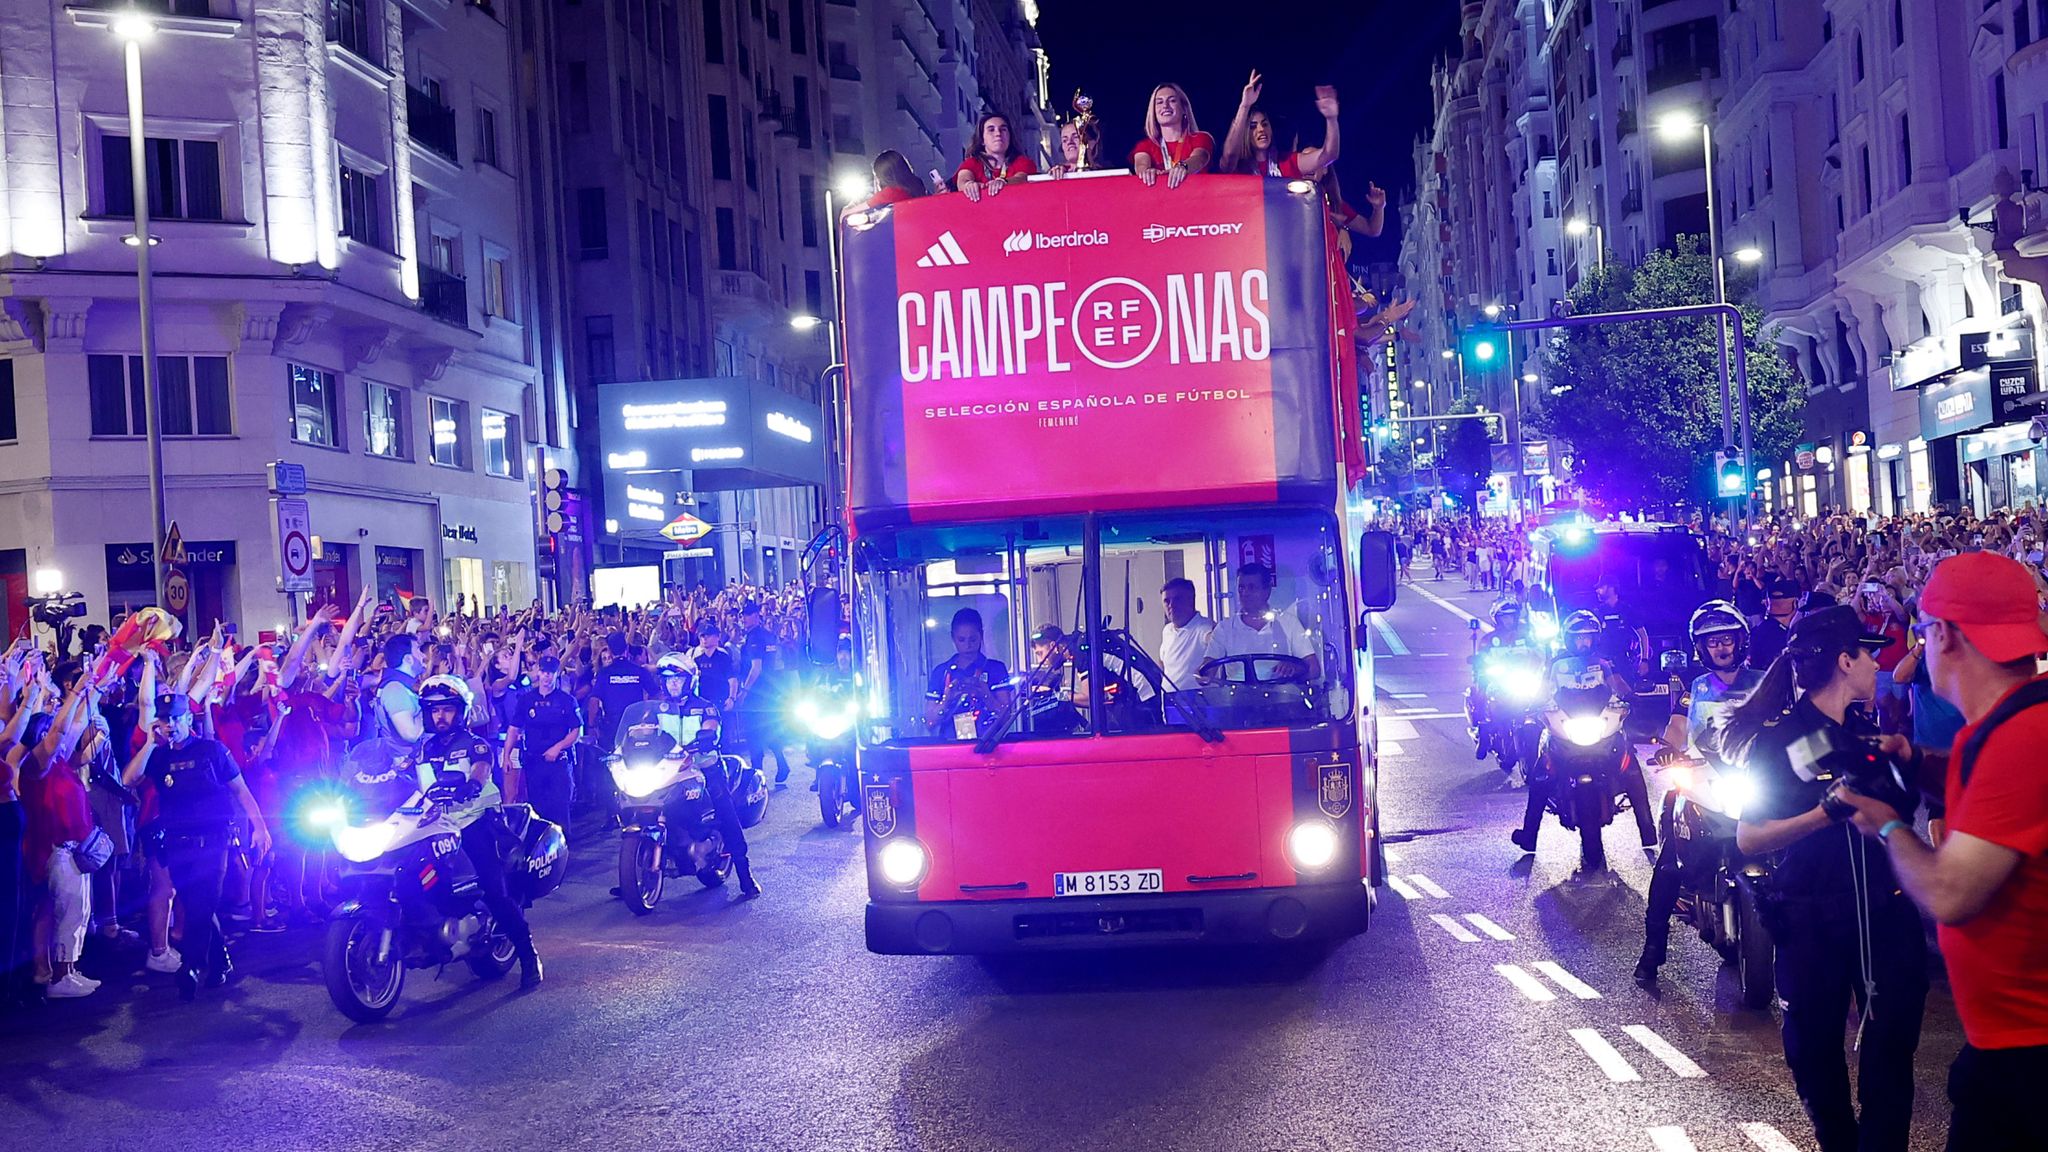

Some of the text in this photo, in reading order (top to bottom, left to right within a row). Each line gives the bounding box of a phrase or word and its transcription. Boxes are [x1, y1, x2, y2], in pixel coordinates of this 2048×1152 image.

[1035, 230, 1109, 249] Iberdrola
[2000, 377, 2025, 386] CUZCO
[2000, 386, 2026, 395] LUPITA
[925, 388, 1250, 418] SELECCIÓN ESPAÑOLA DE FÚTBOL
[442, 523, 457, 539] Dear
[674, 524, 698, 536] Metro
[170, 585, 185, 600] 30
[437, 835, 458, 855] 091
[1066, 872, 1160, 892] M 8153 ZD
